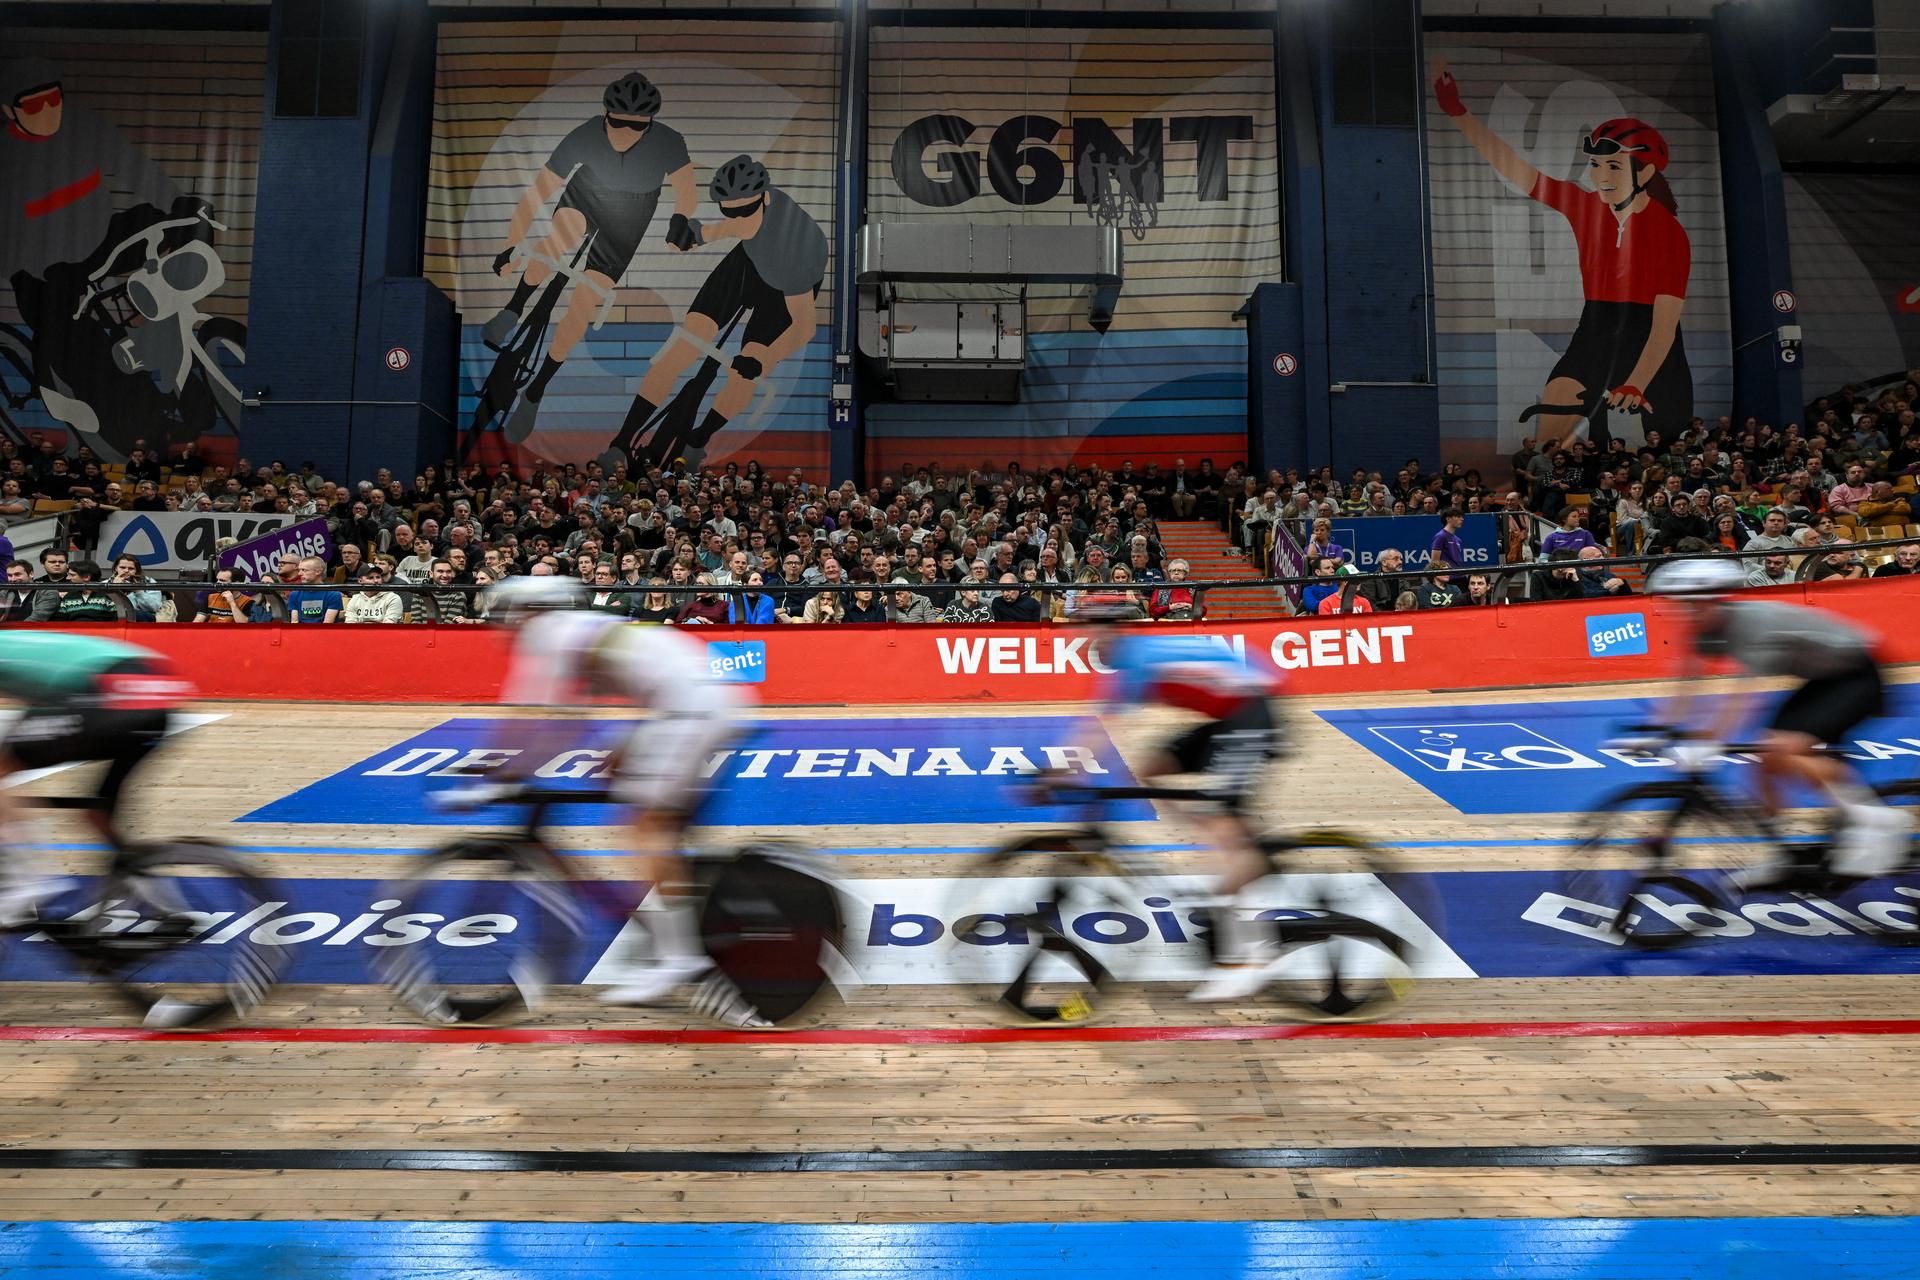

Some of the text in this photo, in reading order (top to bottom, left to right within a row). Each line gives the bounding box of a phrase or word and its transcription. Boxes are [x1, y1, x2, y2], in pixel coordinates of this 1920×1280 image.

[892, 115, 1254, 207] G6NT
[1781, 349, 1796, 363] G
[835, 408, 849, 422] H
[1271, 626, 1414, 669] GENT
[1591, 622, 1643, 652] gent:
[710, 650, 762, 678] gent:
[360, 746, 1109, 778] DE GTENAAR
